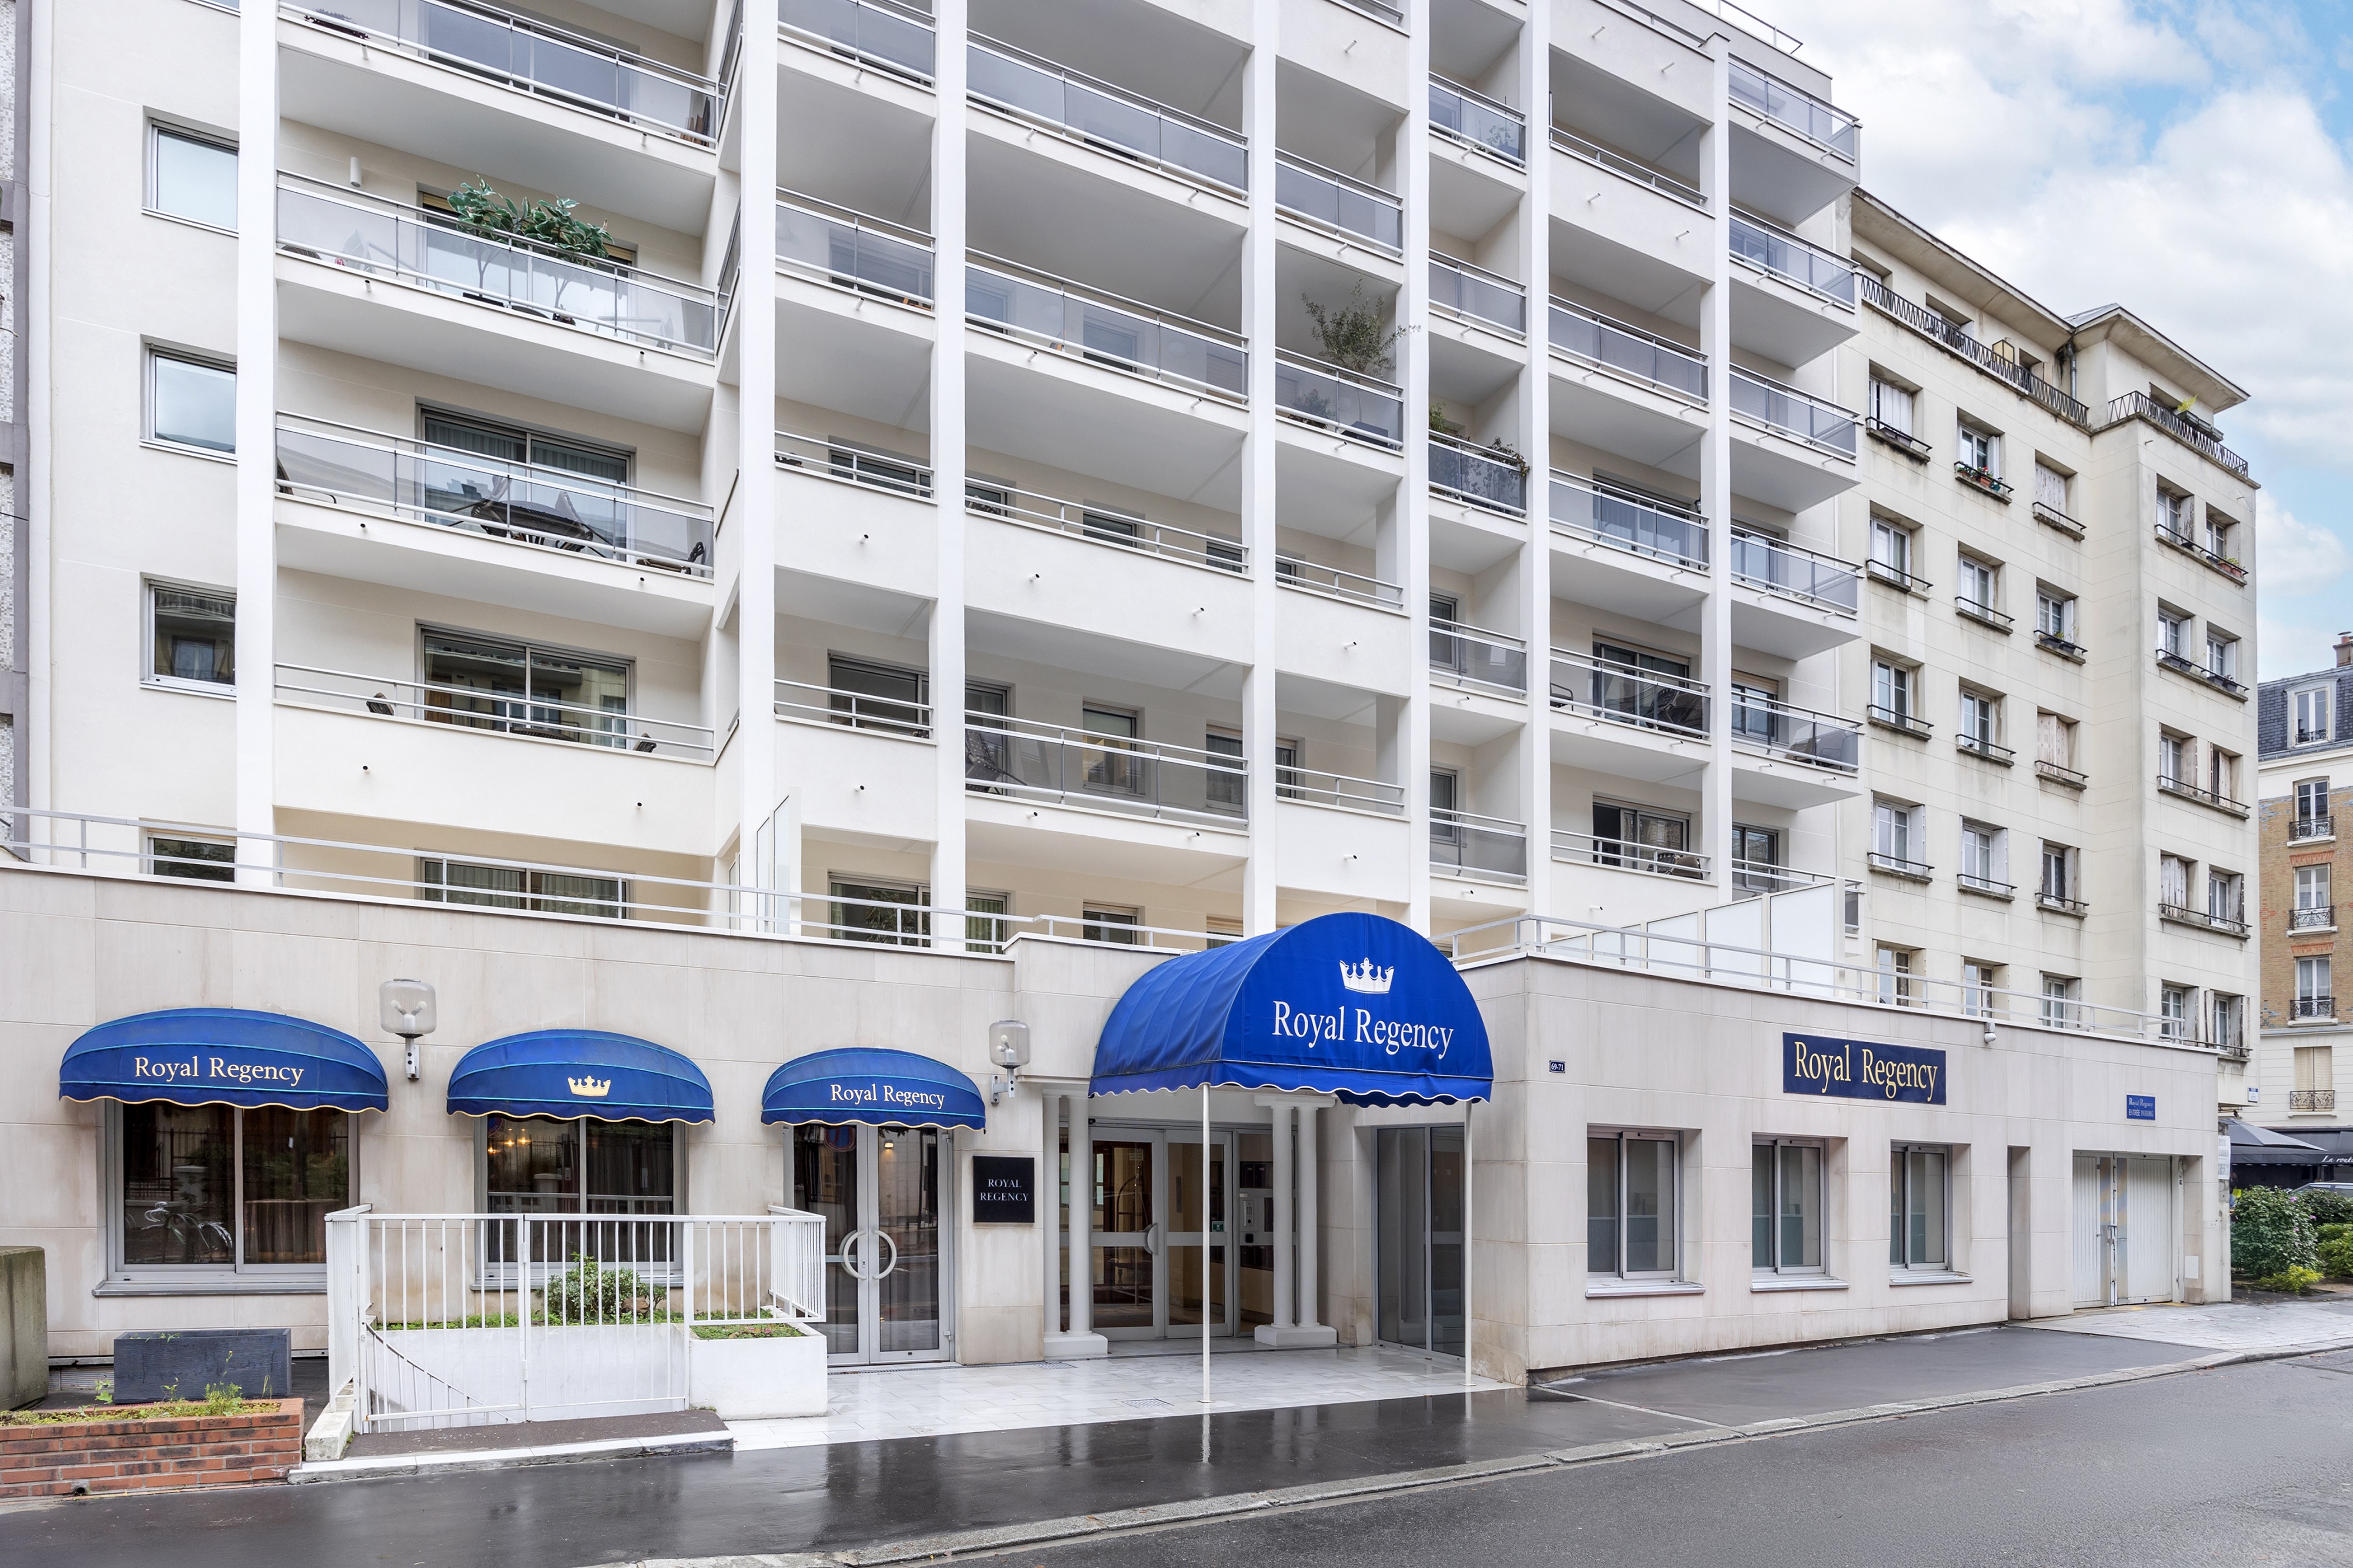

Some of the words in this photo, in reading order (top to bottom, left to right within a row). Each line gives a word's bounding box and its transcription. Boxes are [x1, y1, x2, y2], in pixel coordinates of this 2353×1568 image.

[1272, 1000, 1345, 1048] Royal
[1354, 1008, 1454, 1060] Regency
[135, 1055, 199, 1082] Royal
[209, 1057, 305, 1086] Regency
[1551, 1063, 1564, 1071] 69-71
[1794, 1042, 1851, 1093] Royal
[1862, 1049, 1938, 1102] Regency
[830, 1083, 878, 1105] Royal
[883, 1085, 945, 1110] Regency
[2321, 1155, 2335, 1163] La
[988, 1178, 1022, 1188] ROYAL
[979, 1192, 1029, 1202] REGENCY
